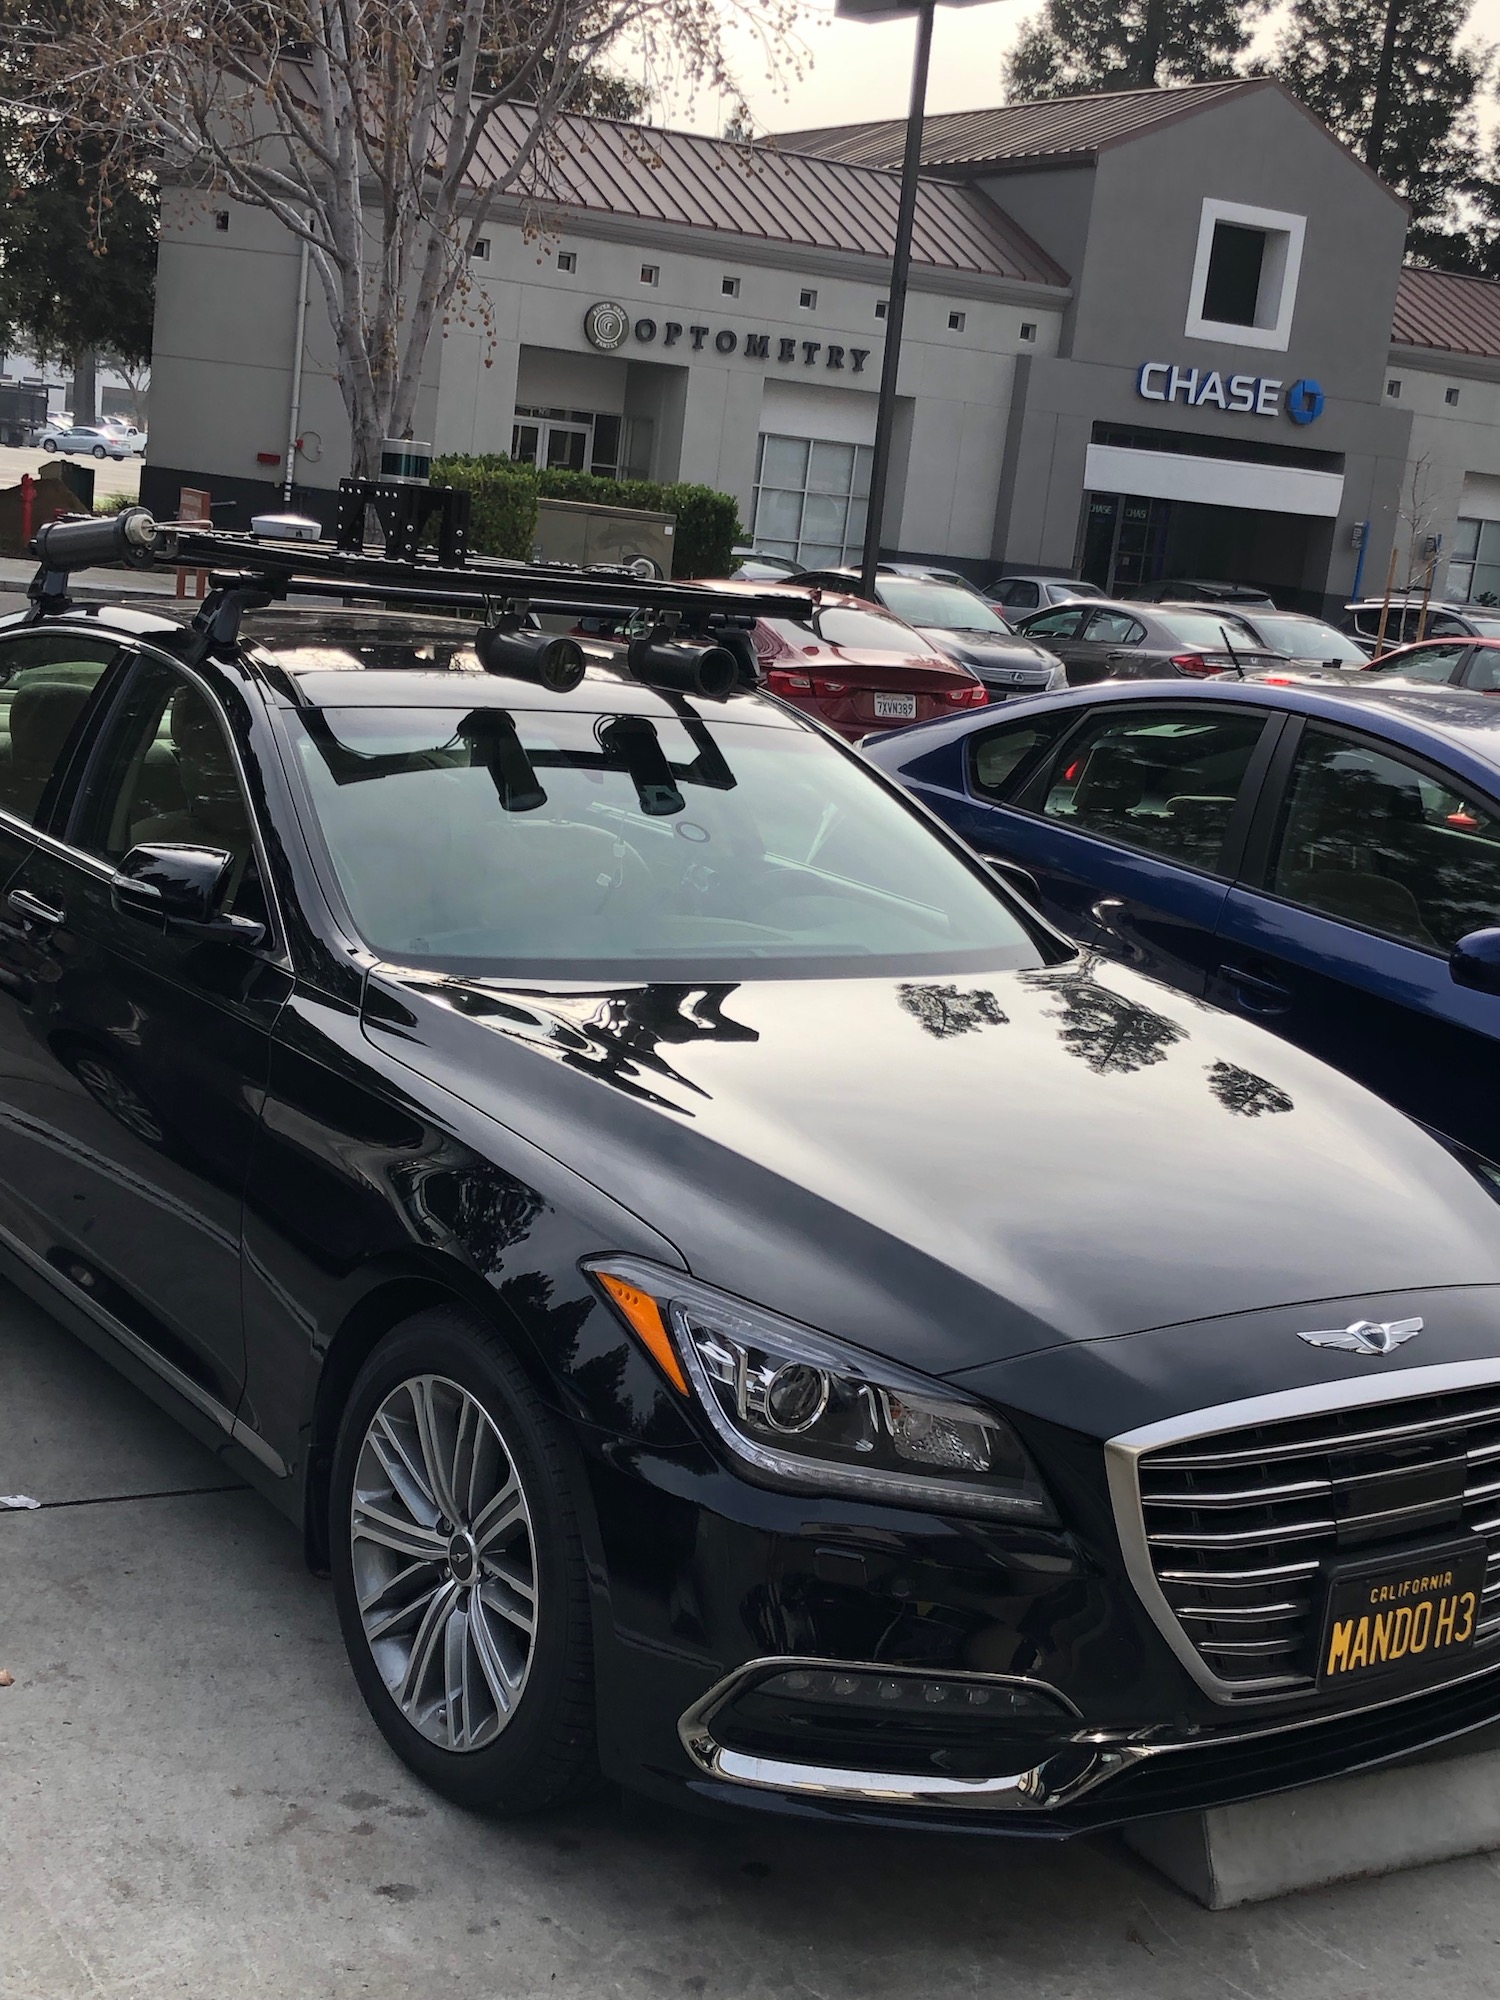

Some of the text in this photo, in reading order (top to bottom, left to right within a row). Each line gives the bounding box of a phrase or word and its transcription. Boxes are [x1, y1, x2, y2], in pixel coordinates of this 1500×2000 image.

[635, 318, 870, 372] OPTOMETRY
[1138, 362, 1283, 416] CHASE
[877, 701, 914, 715] 7XVN389
[1370, 1571, 1453, 1604] CALIFORNIA
[1327, 1592, 1476, 1676] MANDO H3
